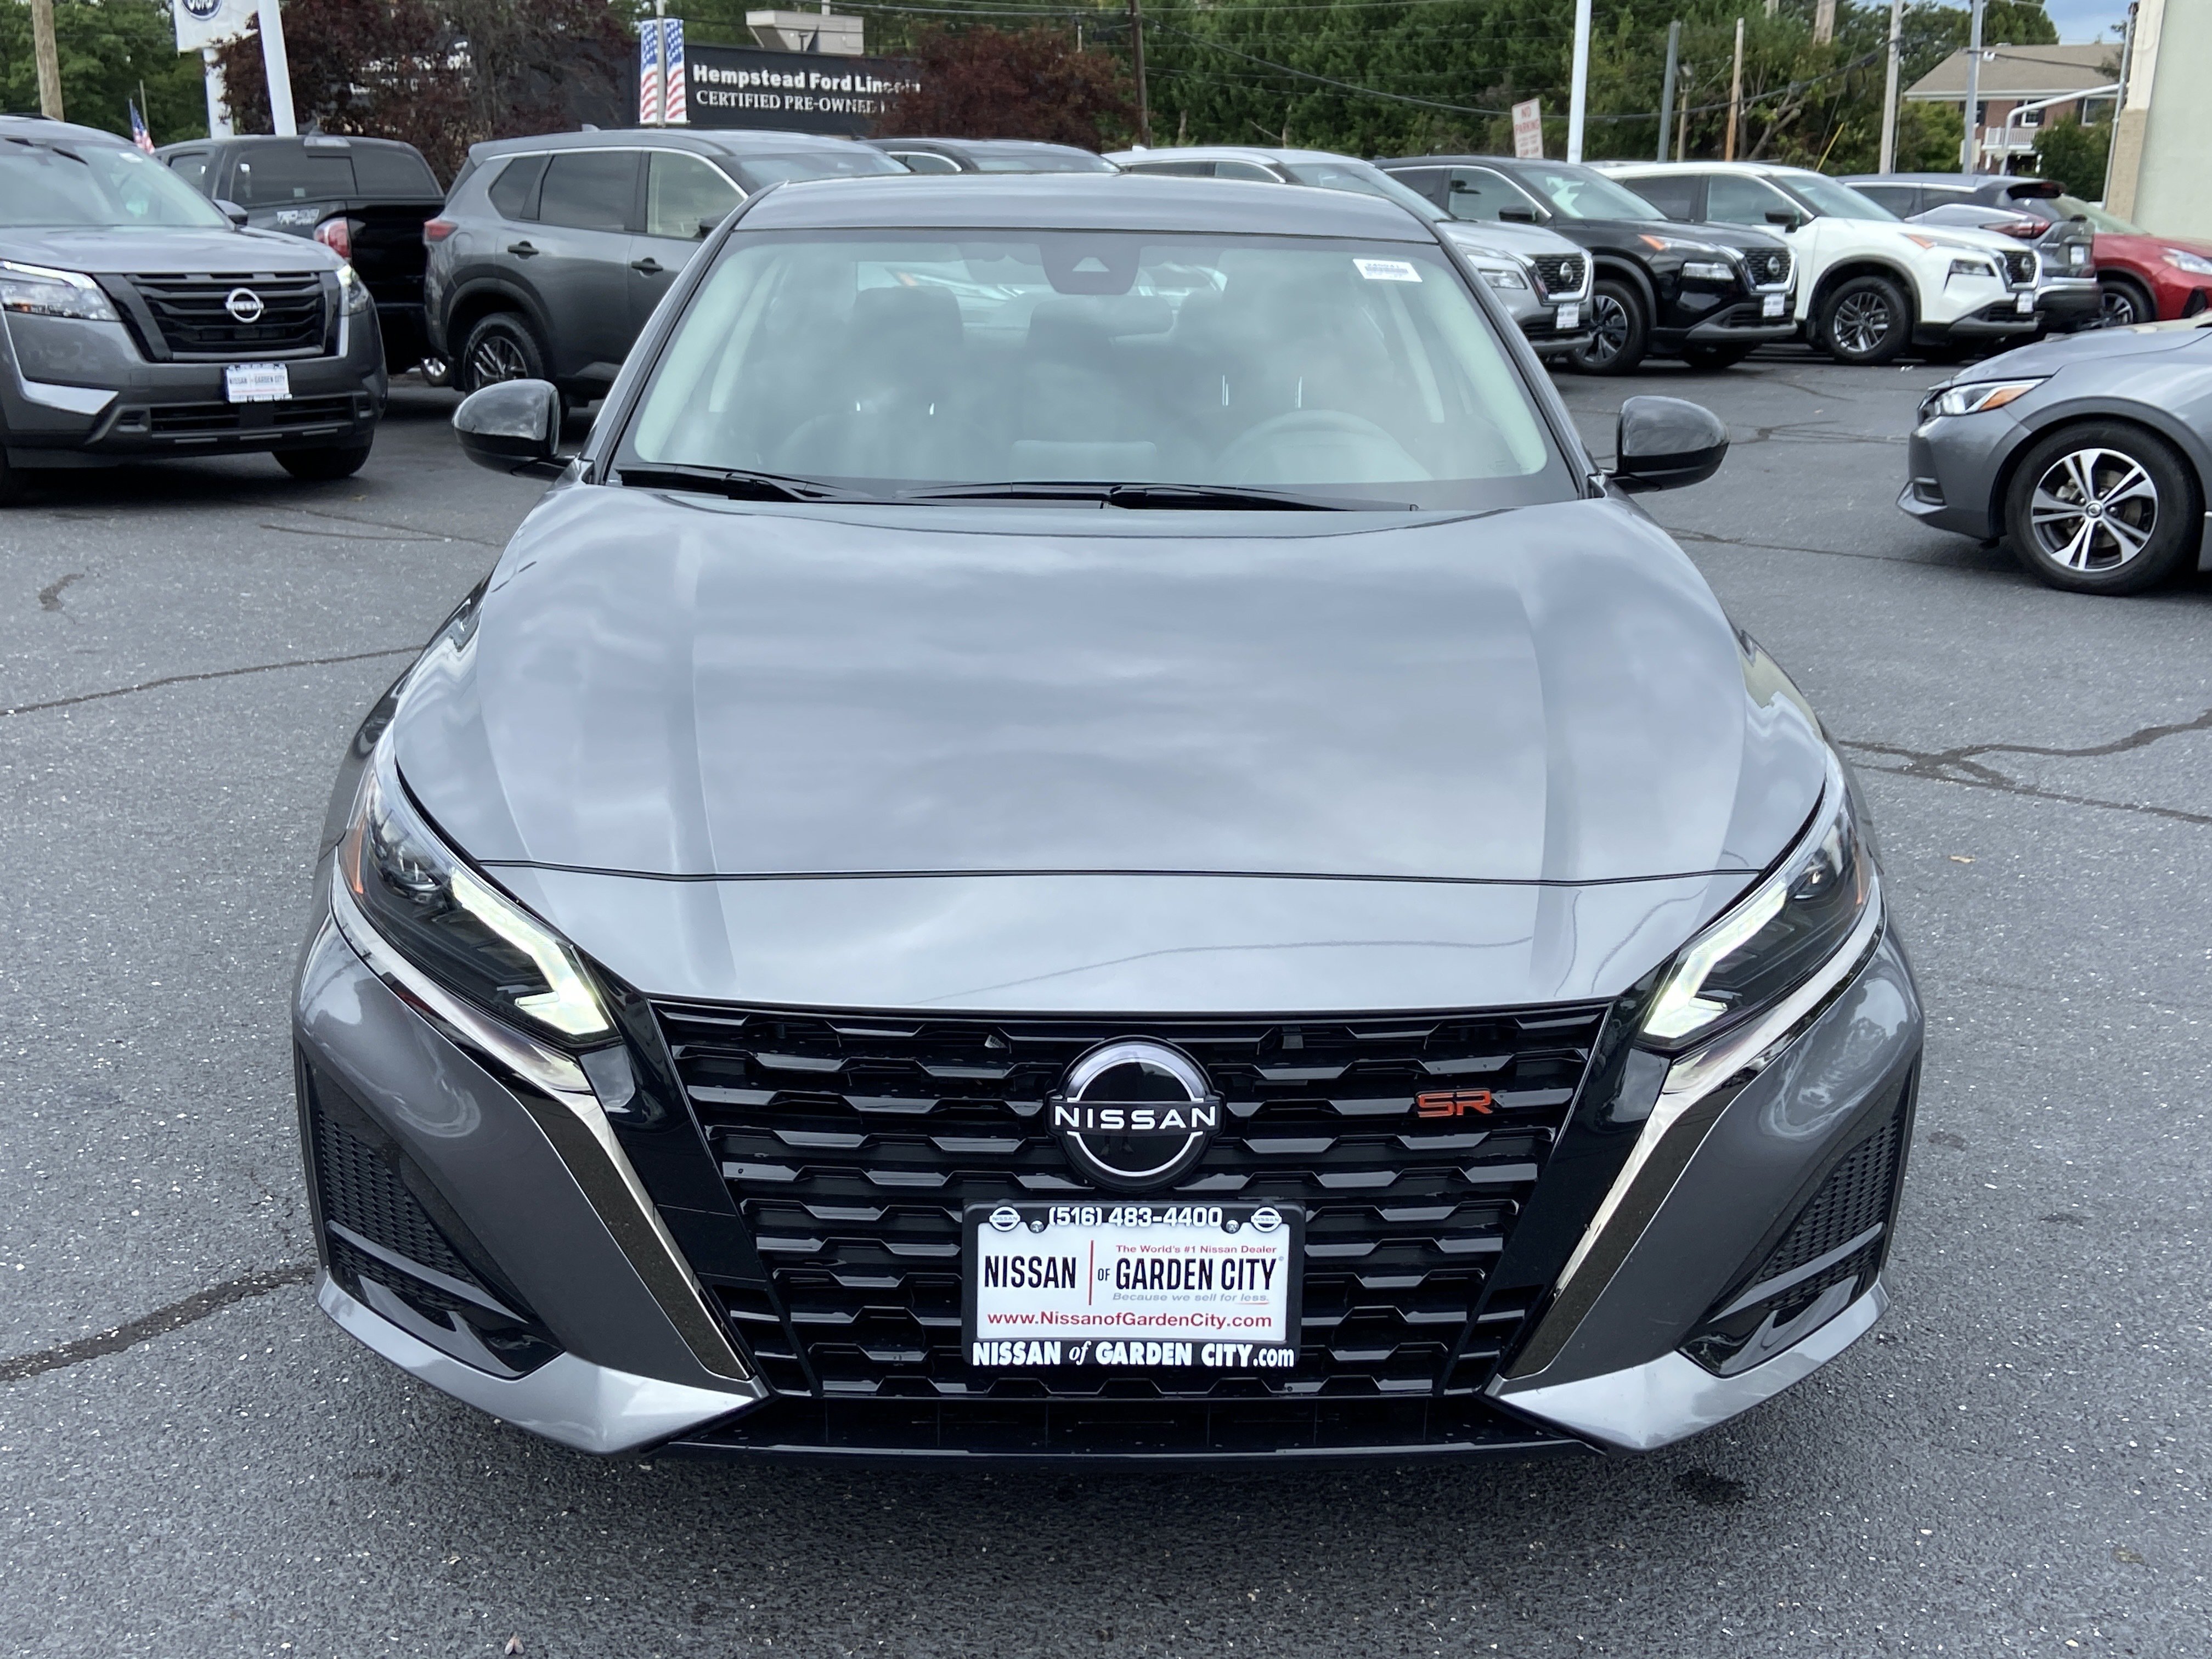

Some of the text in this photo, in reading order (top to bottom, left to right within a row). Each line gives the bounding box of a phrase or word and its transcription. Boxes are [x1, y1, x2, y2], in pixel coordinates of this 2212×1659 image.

[693, 64, 805, 88] Hempstead
[809, 72, 852, 91] Ford
[696, 90, 781, 109] CERTIFIED
[1521, 105, 1531, 117] NO
[1417, 1088, 1493, 1118] SR
[1054, 1105, 1216, 1130] NISSAN
[1049, 1206, 1223, 1228] (516) 483-4400
[1116, 1245, 1277, 1254] The World's #1 Nissan Dealer
[984, 1255, 1277, 1290] NISSAN OF GARDEN CITY
[1113, 1293, 1168, 1301] Because
[1195, 1293, 1217, 1302] sell
[1220, 1293, 1238, 1302] for
[988, 1311, 1272, 1329] www.NissanofGardenCity.com
[972, 1340, 1295, 1368] NISSAN of GARDEN CITY.com
